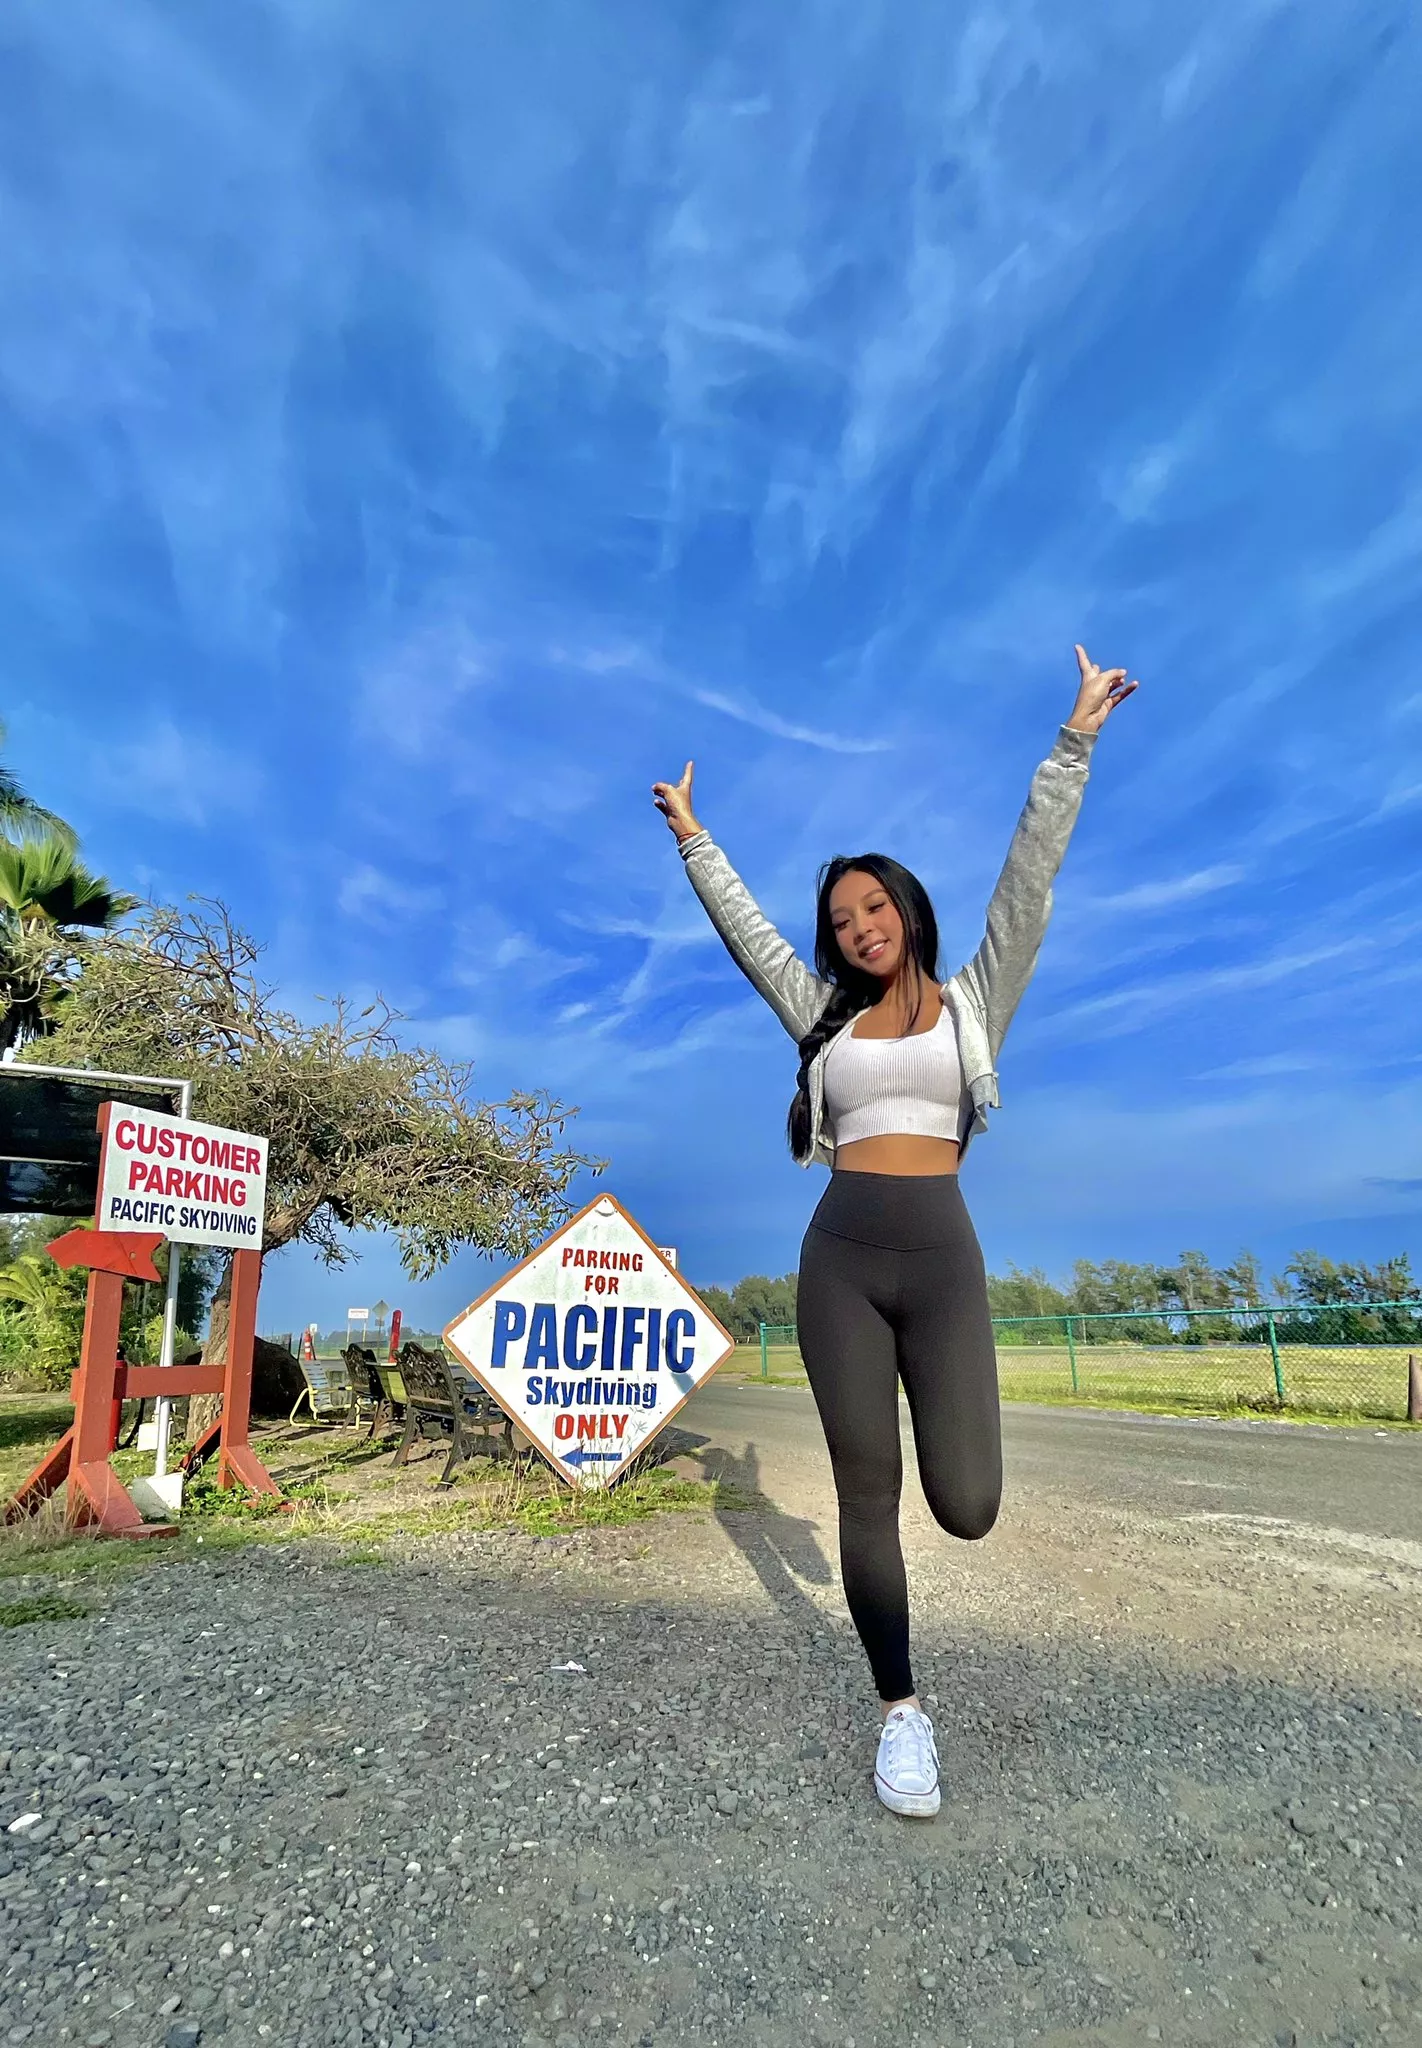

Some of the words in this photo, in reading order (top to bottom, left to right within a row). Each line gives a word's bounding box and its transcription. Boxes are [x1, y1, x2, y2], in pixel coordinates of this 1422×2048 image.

[115, 1119, 261, 1176] CUSTOMER
[128, 1160, 247, 1207] PARKING
[111, 1197, 175, 1226] PACIFIC
[179, 1206, 257, 1236] SKYDIVING
[561, 1247, 643, 1273] PARKING
[584, 1275, 619, 1295] FOR
[490, 1300, 696, 1374] PACIFIC
[526, 1375, 658, 1410] Skydiving
[554, 1413, 629, 1441] ONLY
